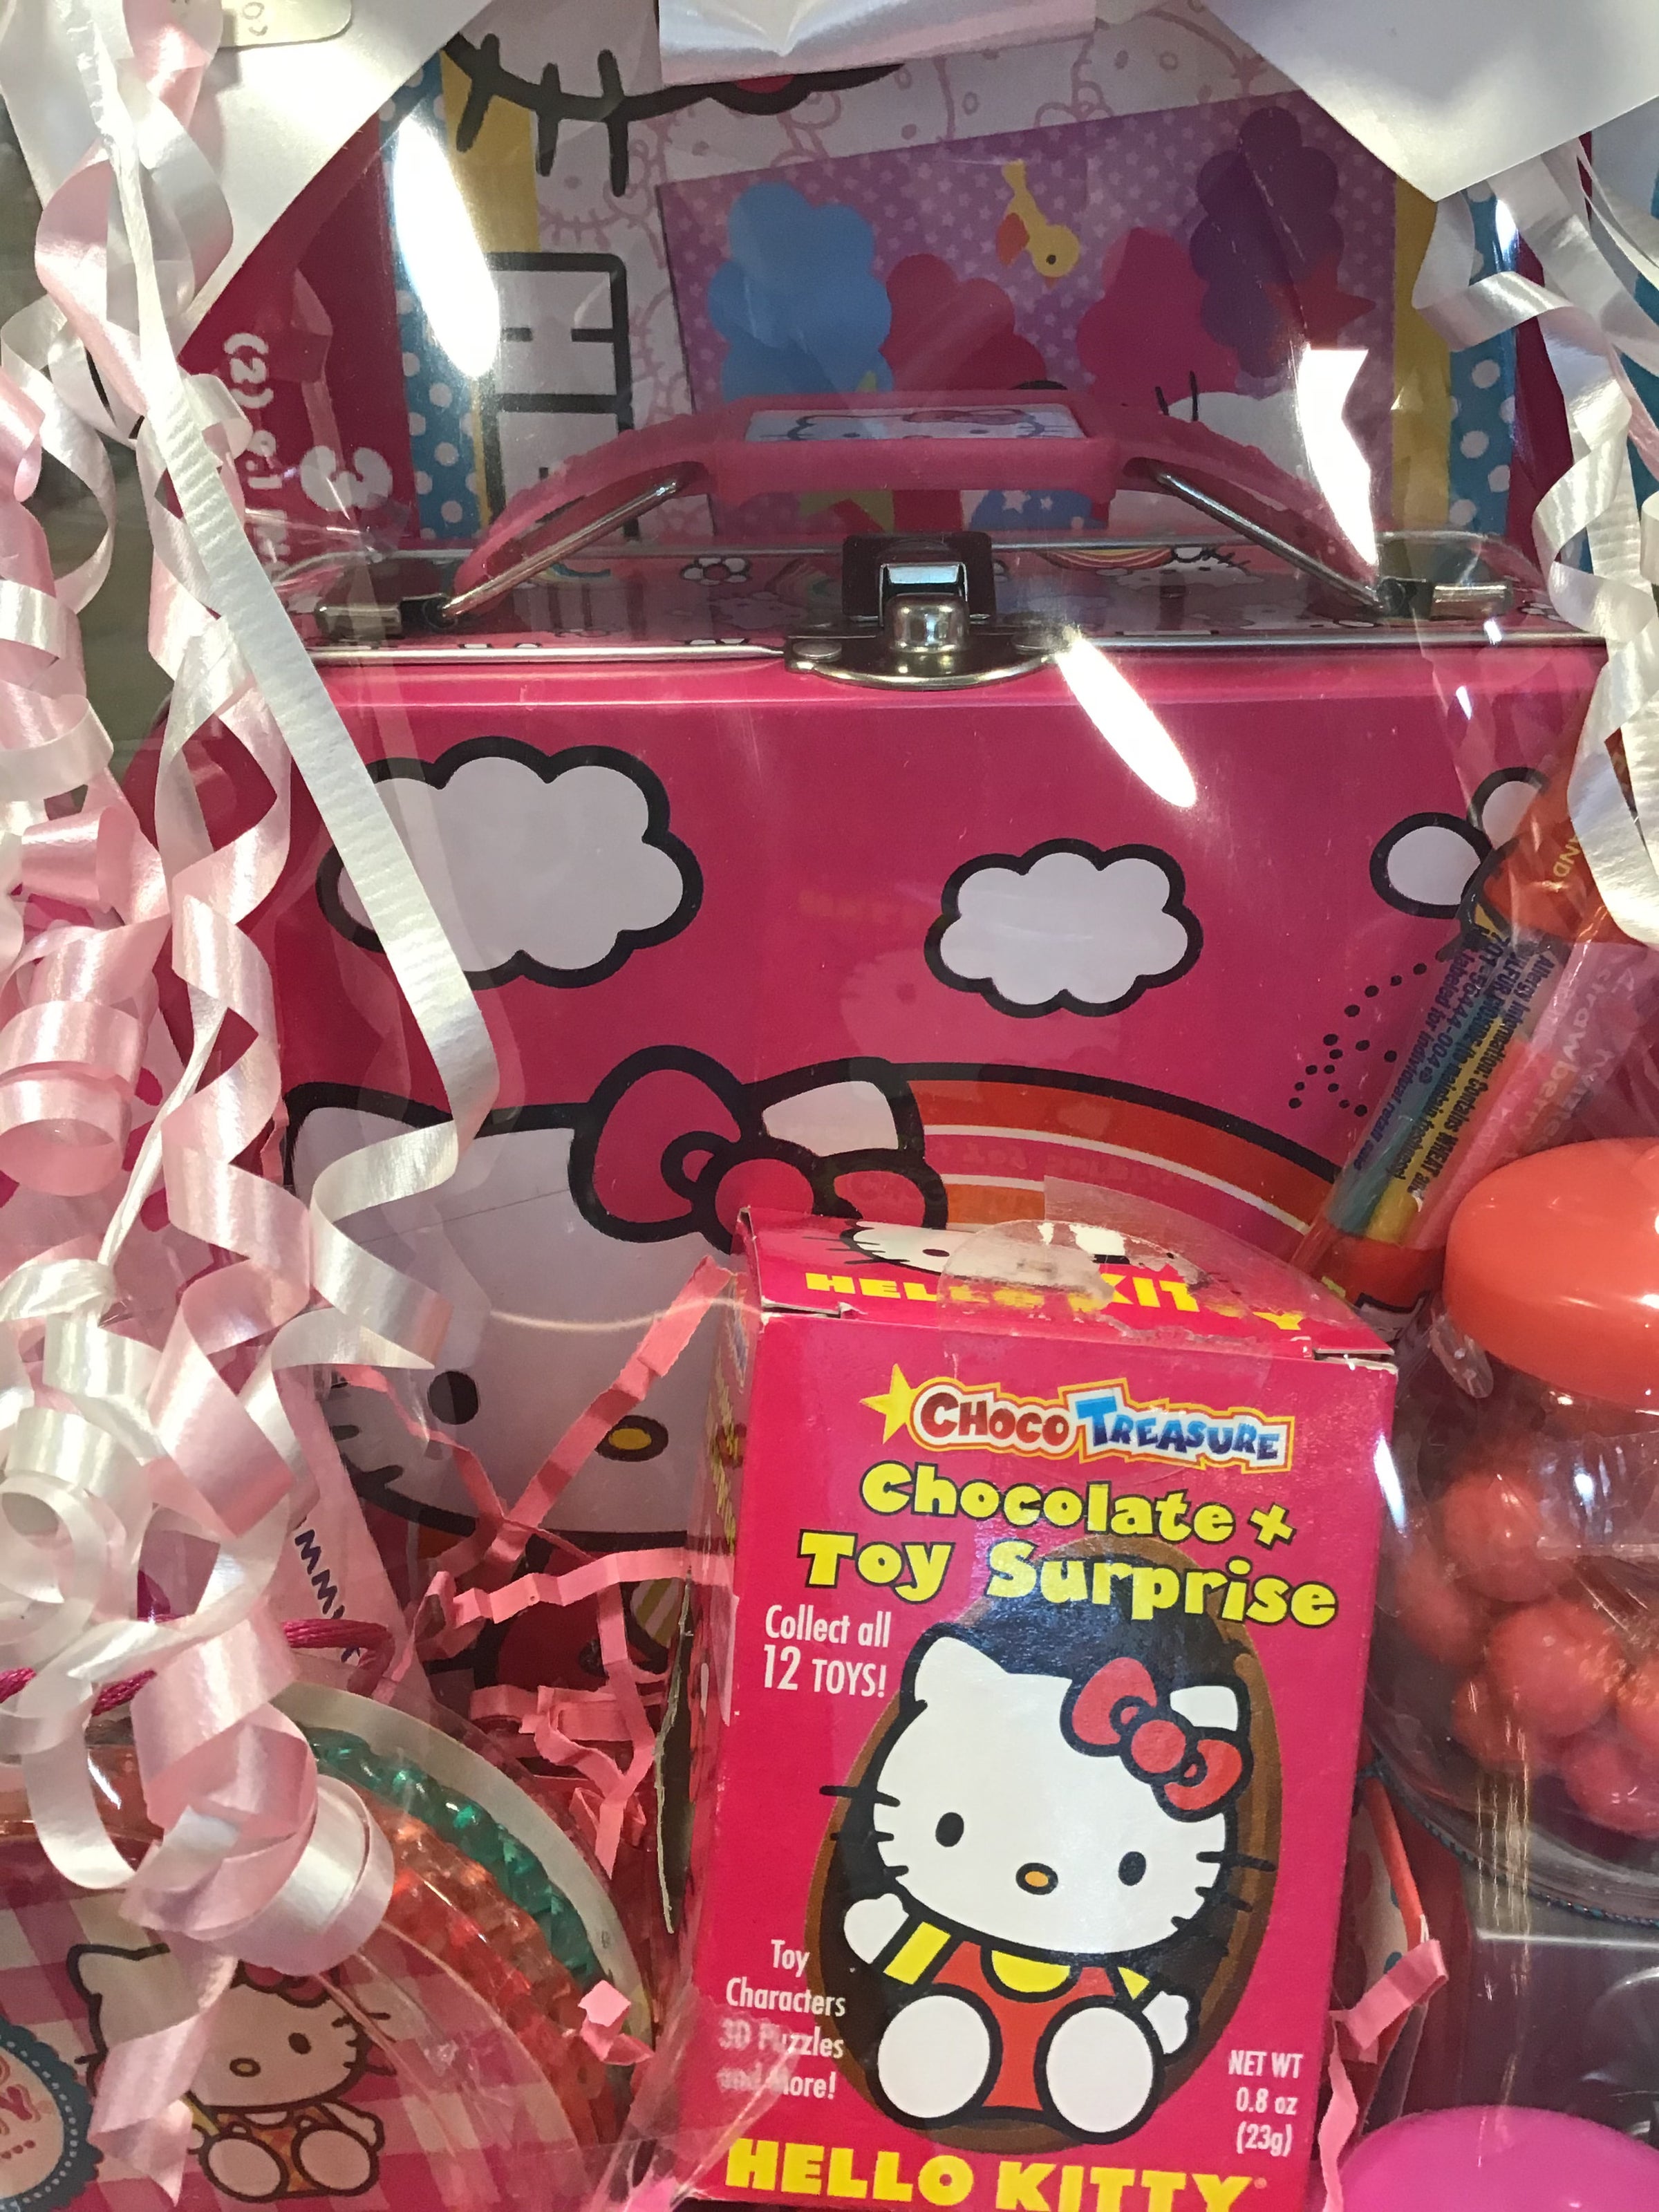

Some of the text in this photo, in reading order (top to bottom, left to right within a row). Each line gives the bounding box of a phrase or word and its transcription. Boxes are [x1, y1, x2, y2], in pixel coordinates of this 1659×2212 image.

[1513, 954, 1555, 1005] Allergy
[1426, 1009, 1446, 1030] for
[1472, 1000, 1531, 1082] Information:
[1389, 1030, 1434, 1102] individual
[1420, 1061, 1467, 1122] maintain
[1442, 1076, 1490, 1136] Contains
[1369, 1101, 1397, 1142] retail
[1418, 1129, 1459, 1179] WHEAT
[919, 1389, 1281, 1462] CHOCO TREASURE
[859, 1460, 1235, 1544] Chocolate
[797, 1529, 1338, 1629] Toy Surprise
[765, 1605, 890, 1649] Collect all
[764, 1644, 886, 1698] 12 TOYS!
[771, 1940, 809, 1978] Toy
[727, 1976, 845, 2017] Characters
[768, 2071, 836, 2099] ore!
[1228, 2050, 1304, 2079] NET WT
[1236, 2086, 1298, 2115] 0.8 oz
[1237, 2121, 1293, 2157] (23g)
[725, 2138, 1254, 2212] HELLO KITTY
